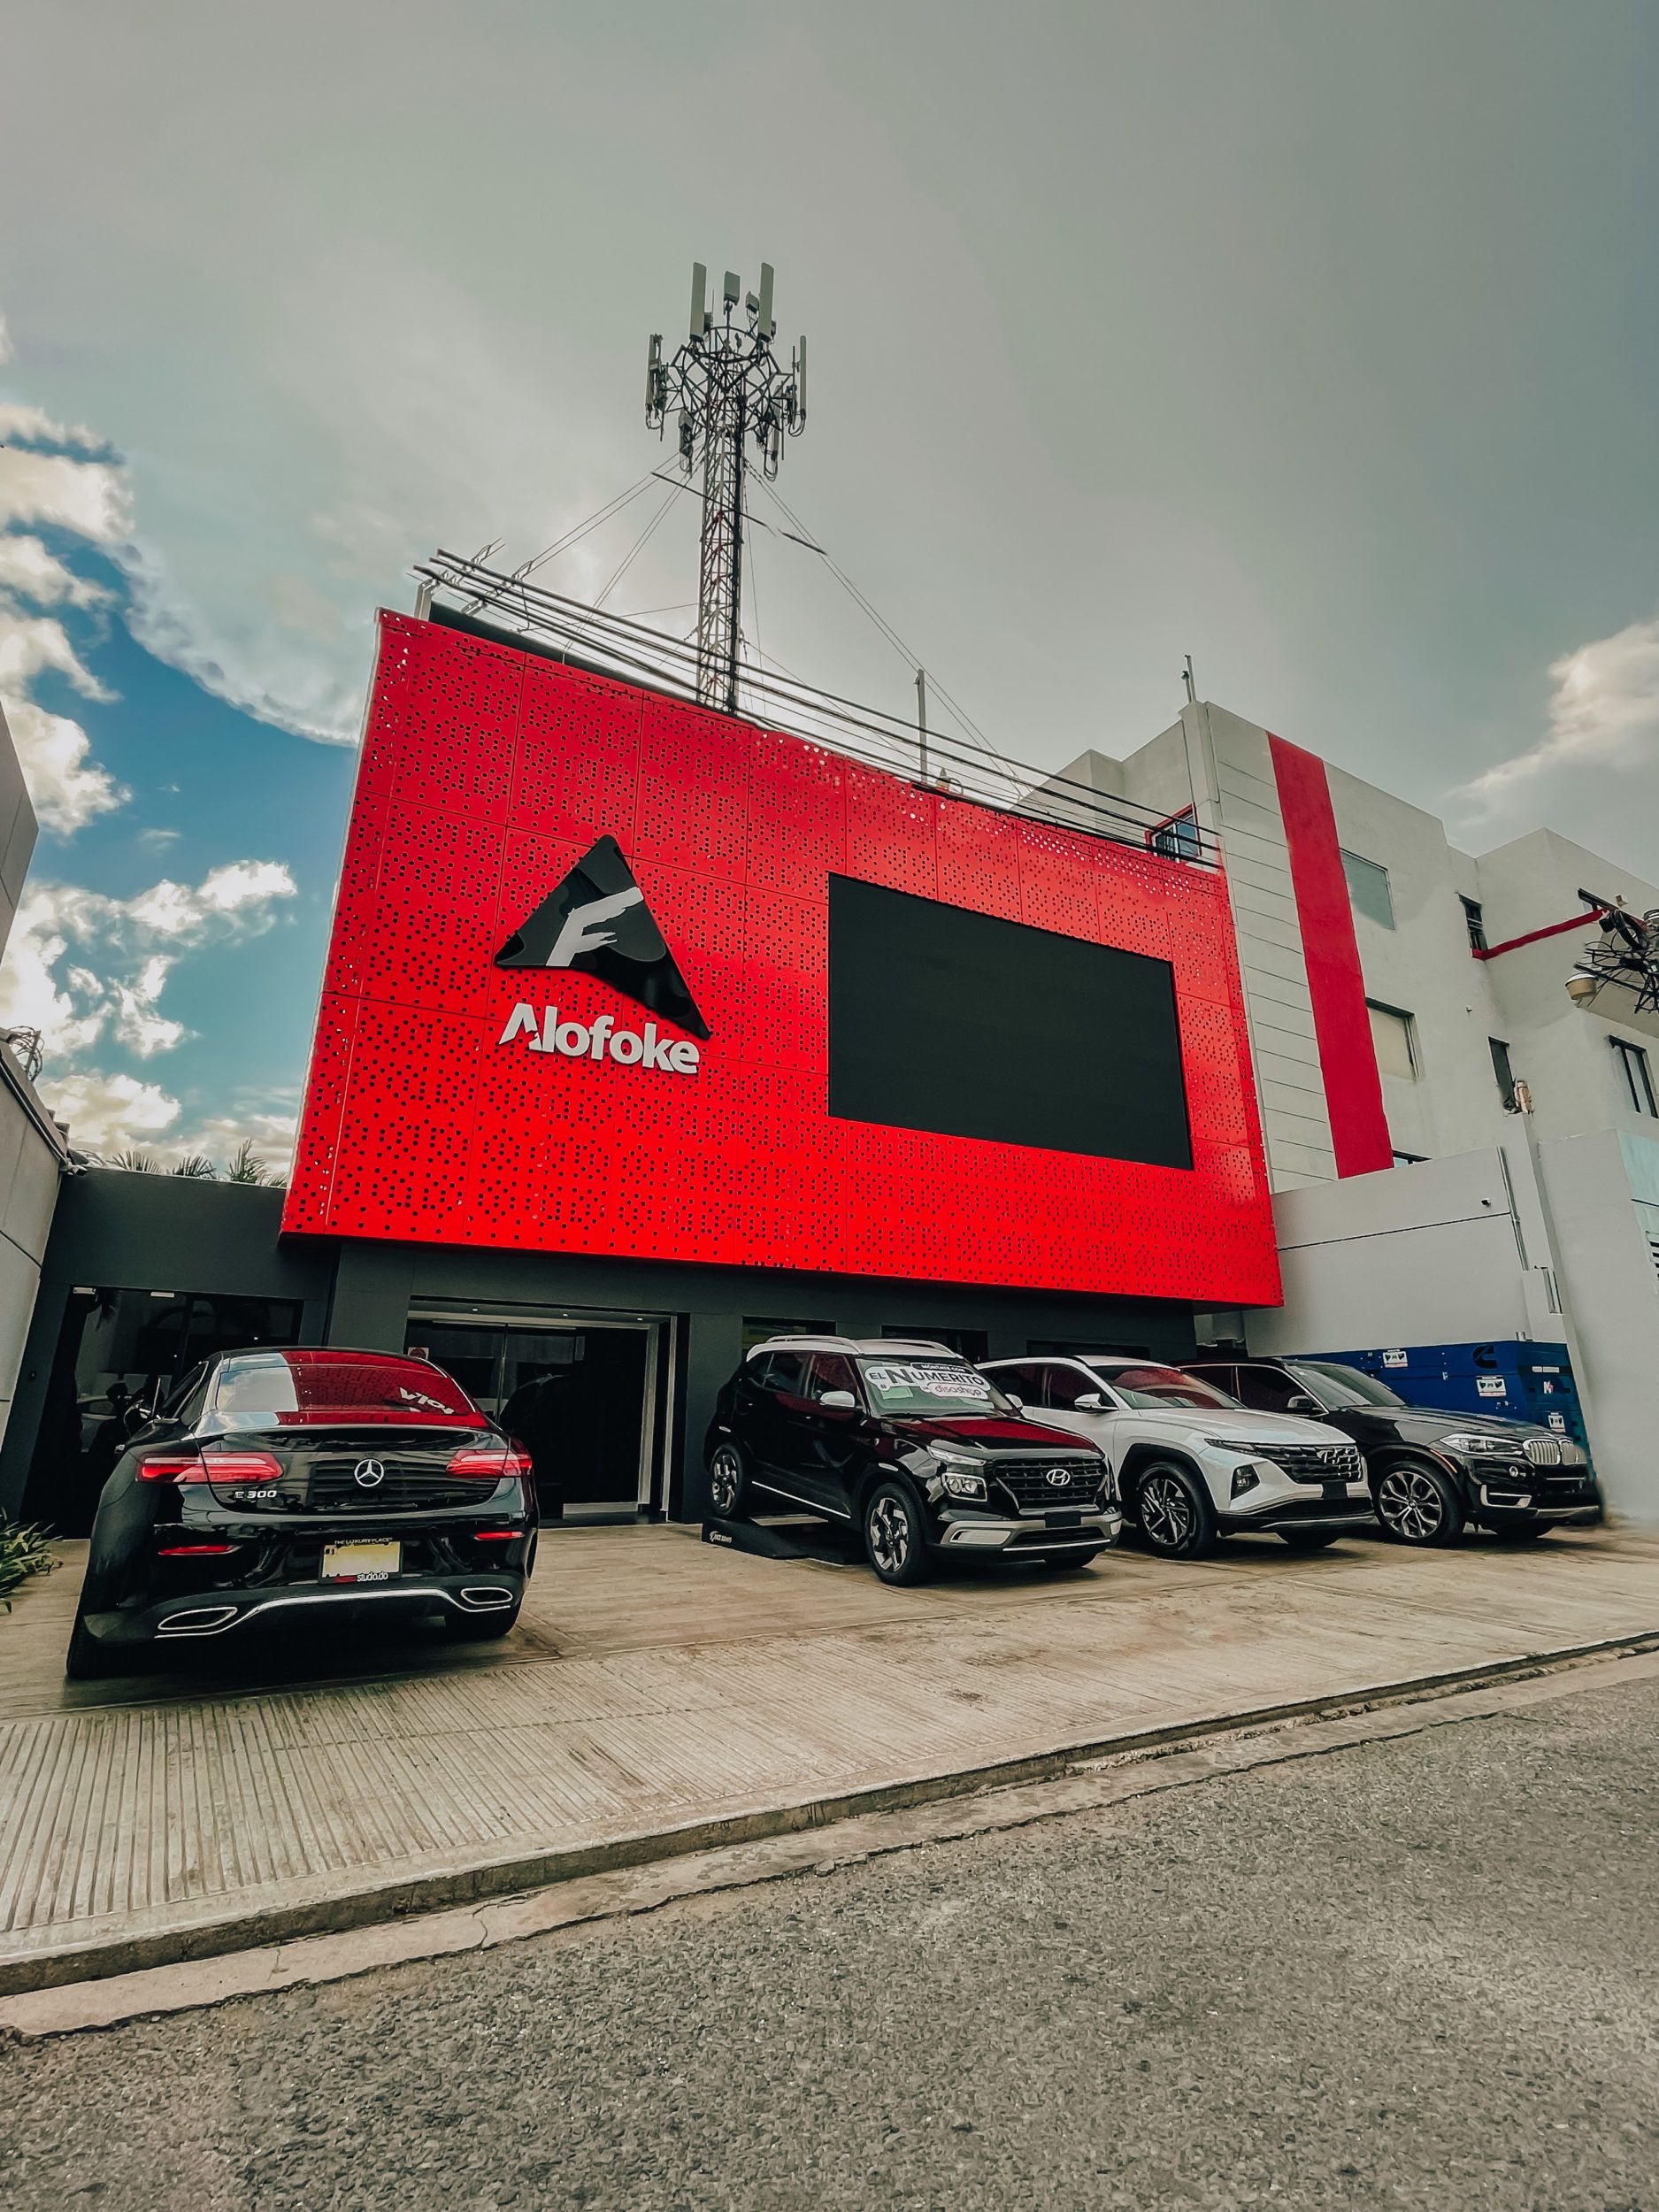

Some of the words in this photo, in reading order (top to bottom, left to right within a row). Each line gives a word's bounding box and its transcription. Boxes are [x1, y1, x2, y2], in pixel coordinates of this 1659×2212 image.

[498, 1002, 701, 1075] Alofoke
[885, 1368, 985, 1386] NUMERITO
[246, 1490, 278, 1499] 300
